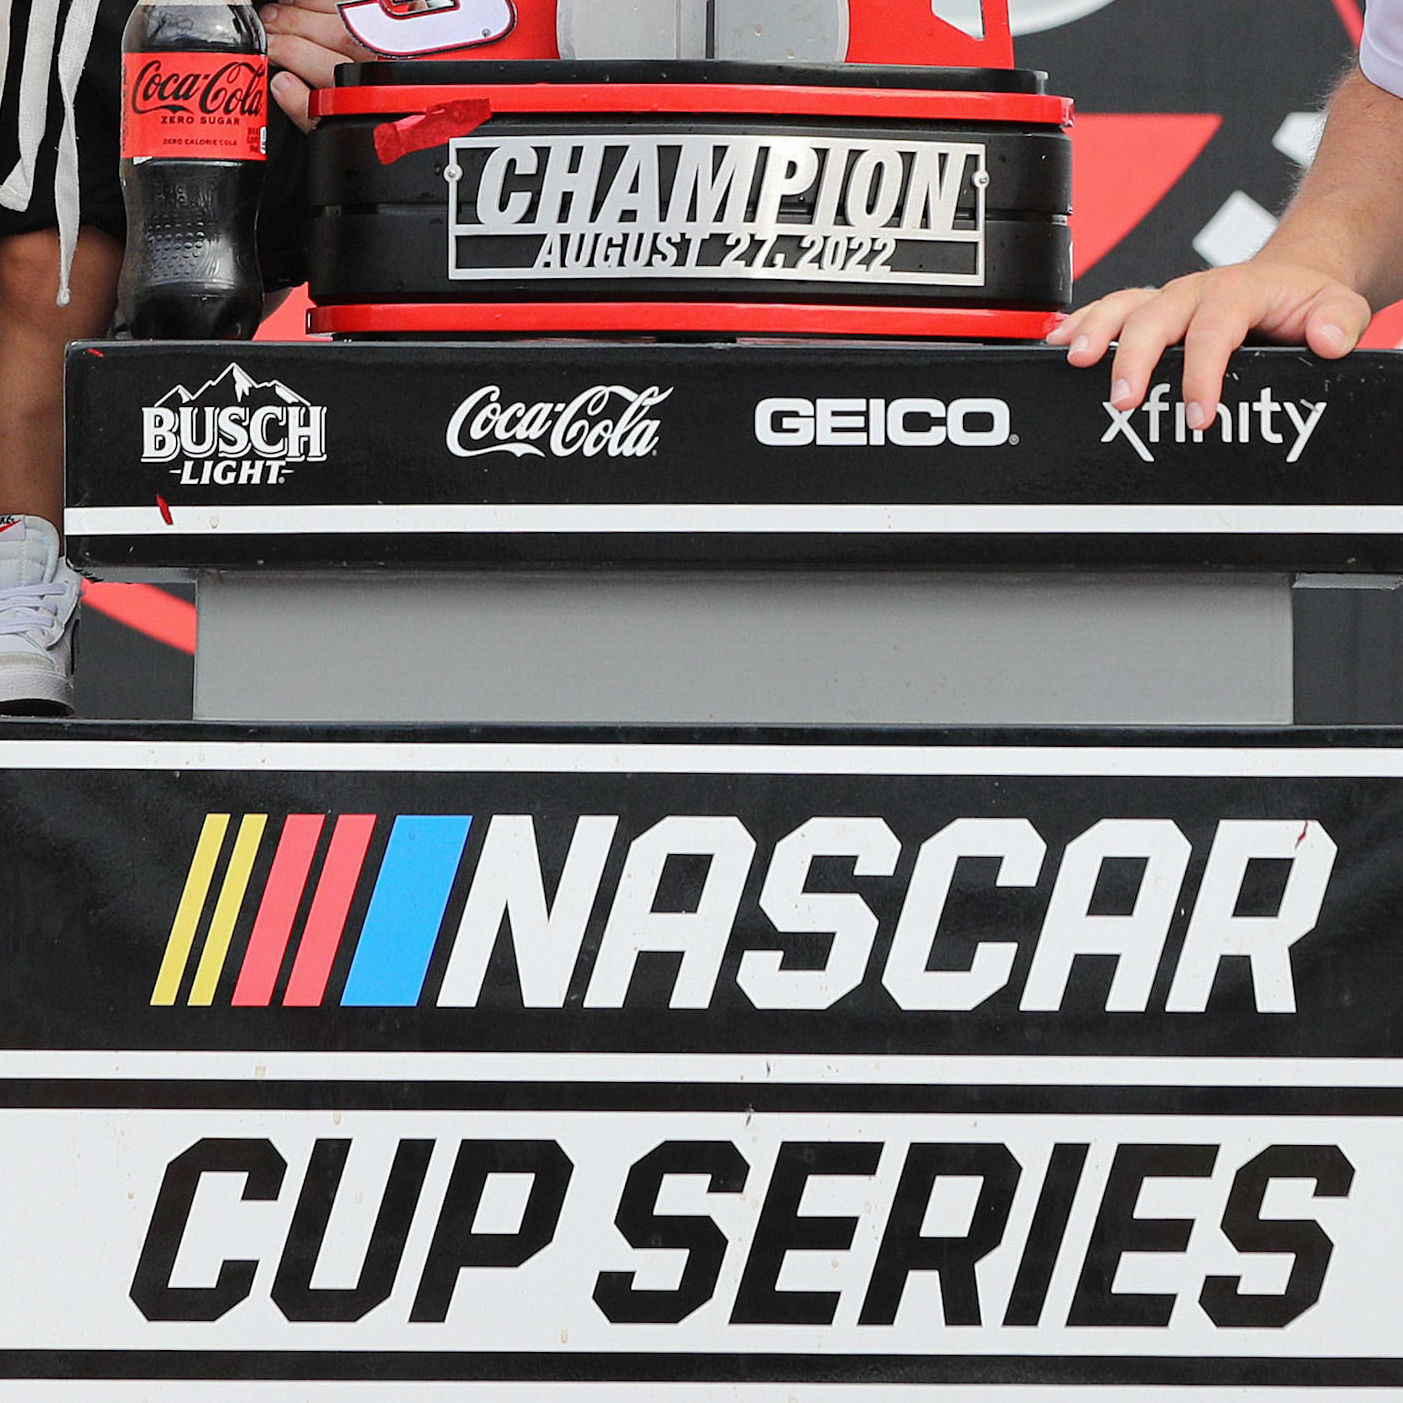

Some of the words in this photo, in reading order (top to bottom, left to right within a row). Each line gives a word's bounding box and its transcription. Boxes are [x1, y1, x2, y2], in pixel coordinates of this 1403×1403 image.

[131, 59, 265, 117] Coca-Cola
[160, 116, 195, 125] ZERO
[200, 116, 240, 126] SUGAR
[476, 145, 968, 231] CHAMPION
[534, 232, 710, 270] AUGUST
[799, 235, 896, 273] 2022
[141, 405, 328, 464] BUSCH
[446, 384, 674, 458] Coca-Cola
[754, 398, 1011, 447] GEICO
[180, 461, 286, 485] LIGHT
[436, 814, 1340, 1014] NASCAR
[129, 1138, 574, 1326] CUP
[592, 1139, 1356, 1330] SERIES
